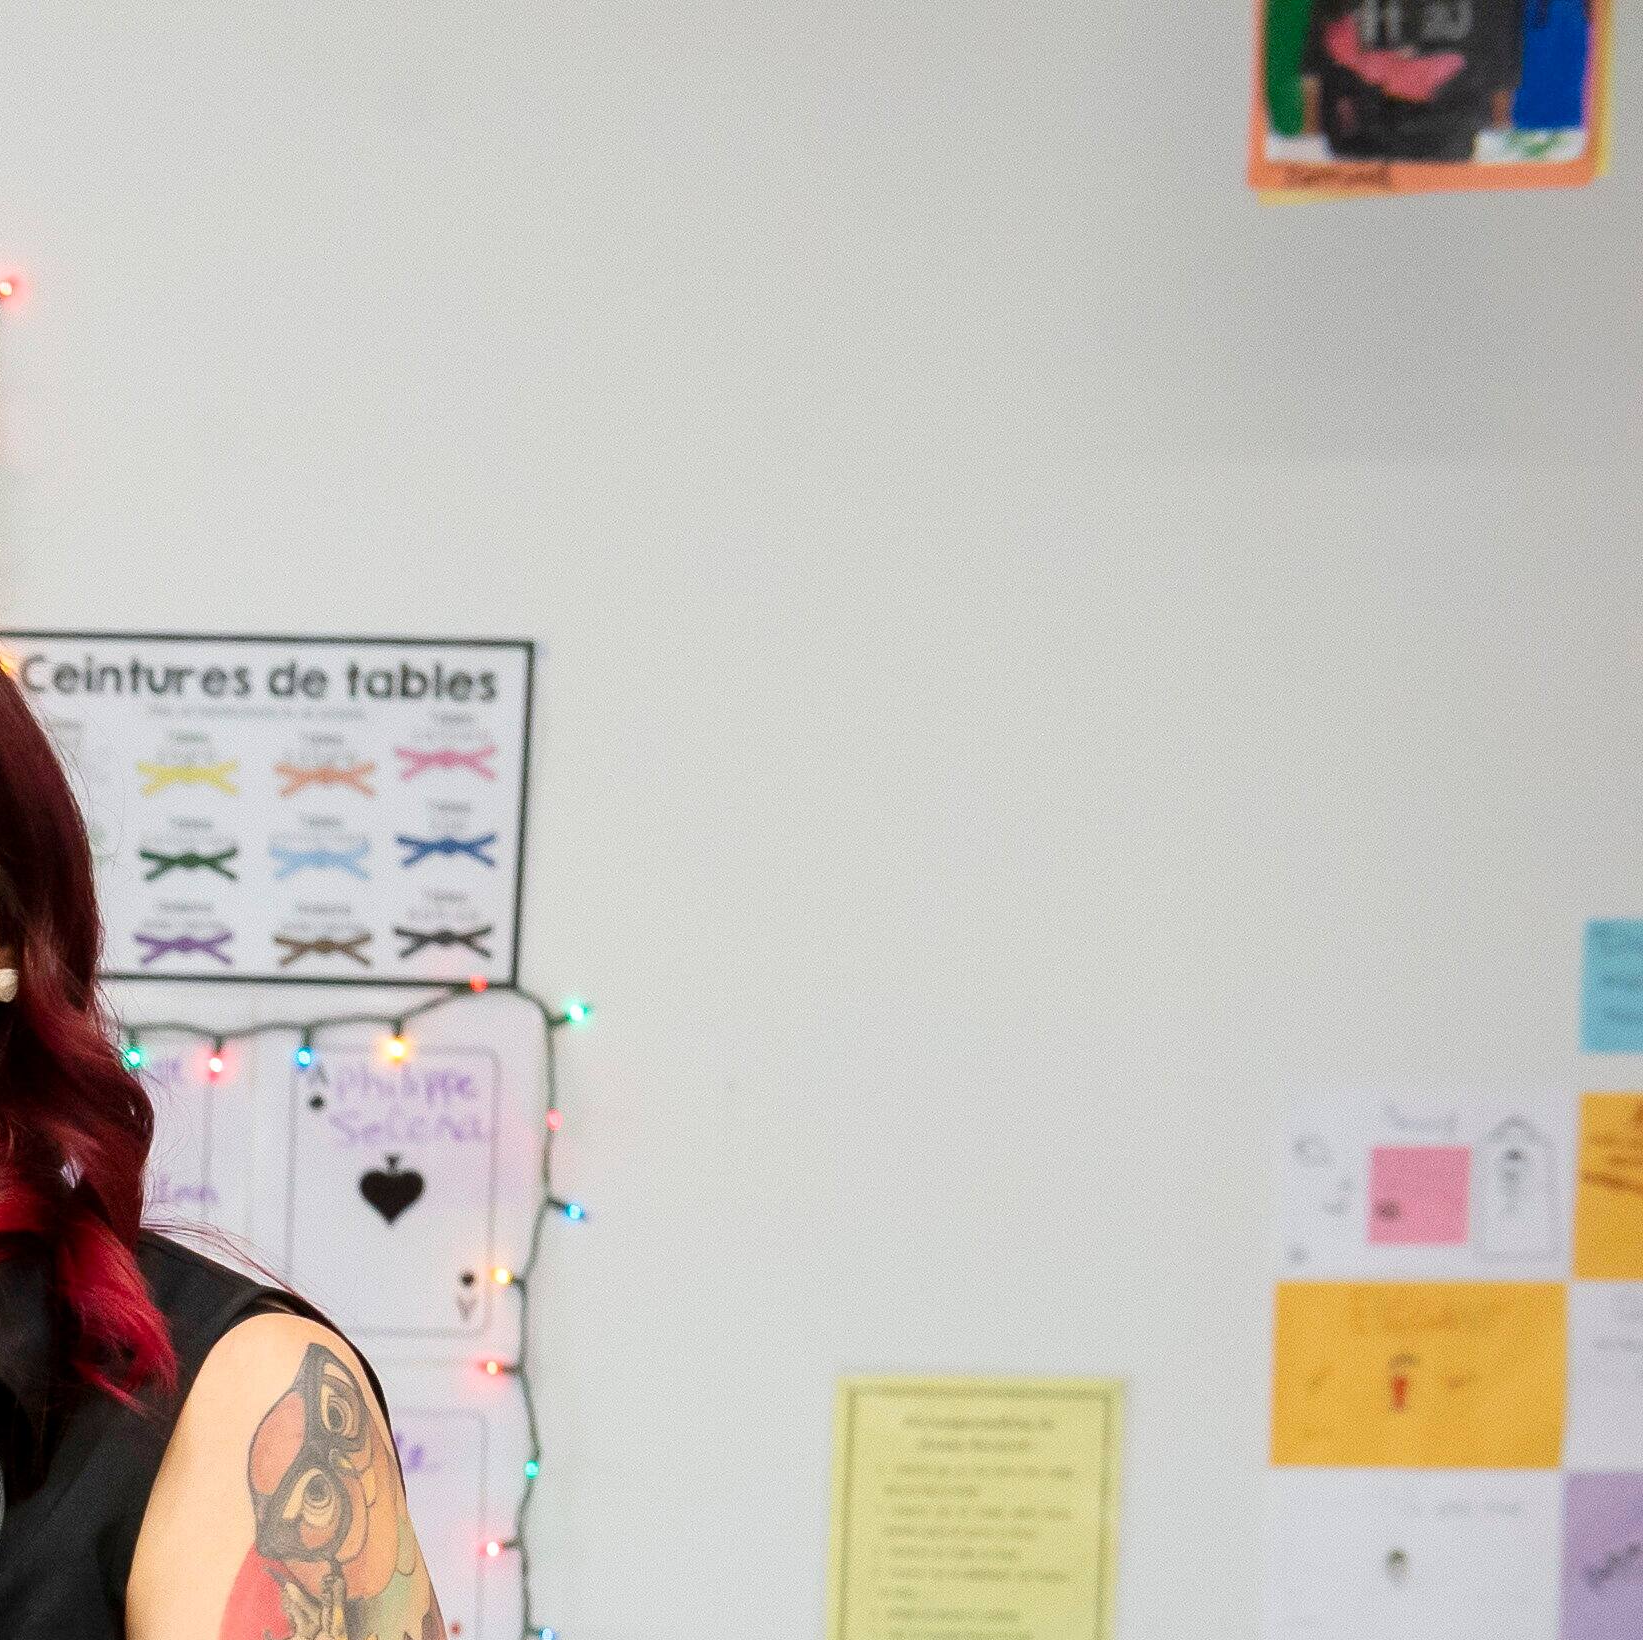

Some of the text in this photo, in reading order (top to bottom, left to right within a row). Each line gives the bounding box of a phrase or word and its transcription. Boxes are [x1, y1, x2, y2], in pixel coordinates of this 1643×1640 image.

[19, 652, 499, 703] Ceintures de tables
